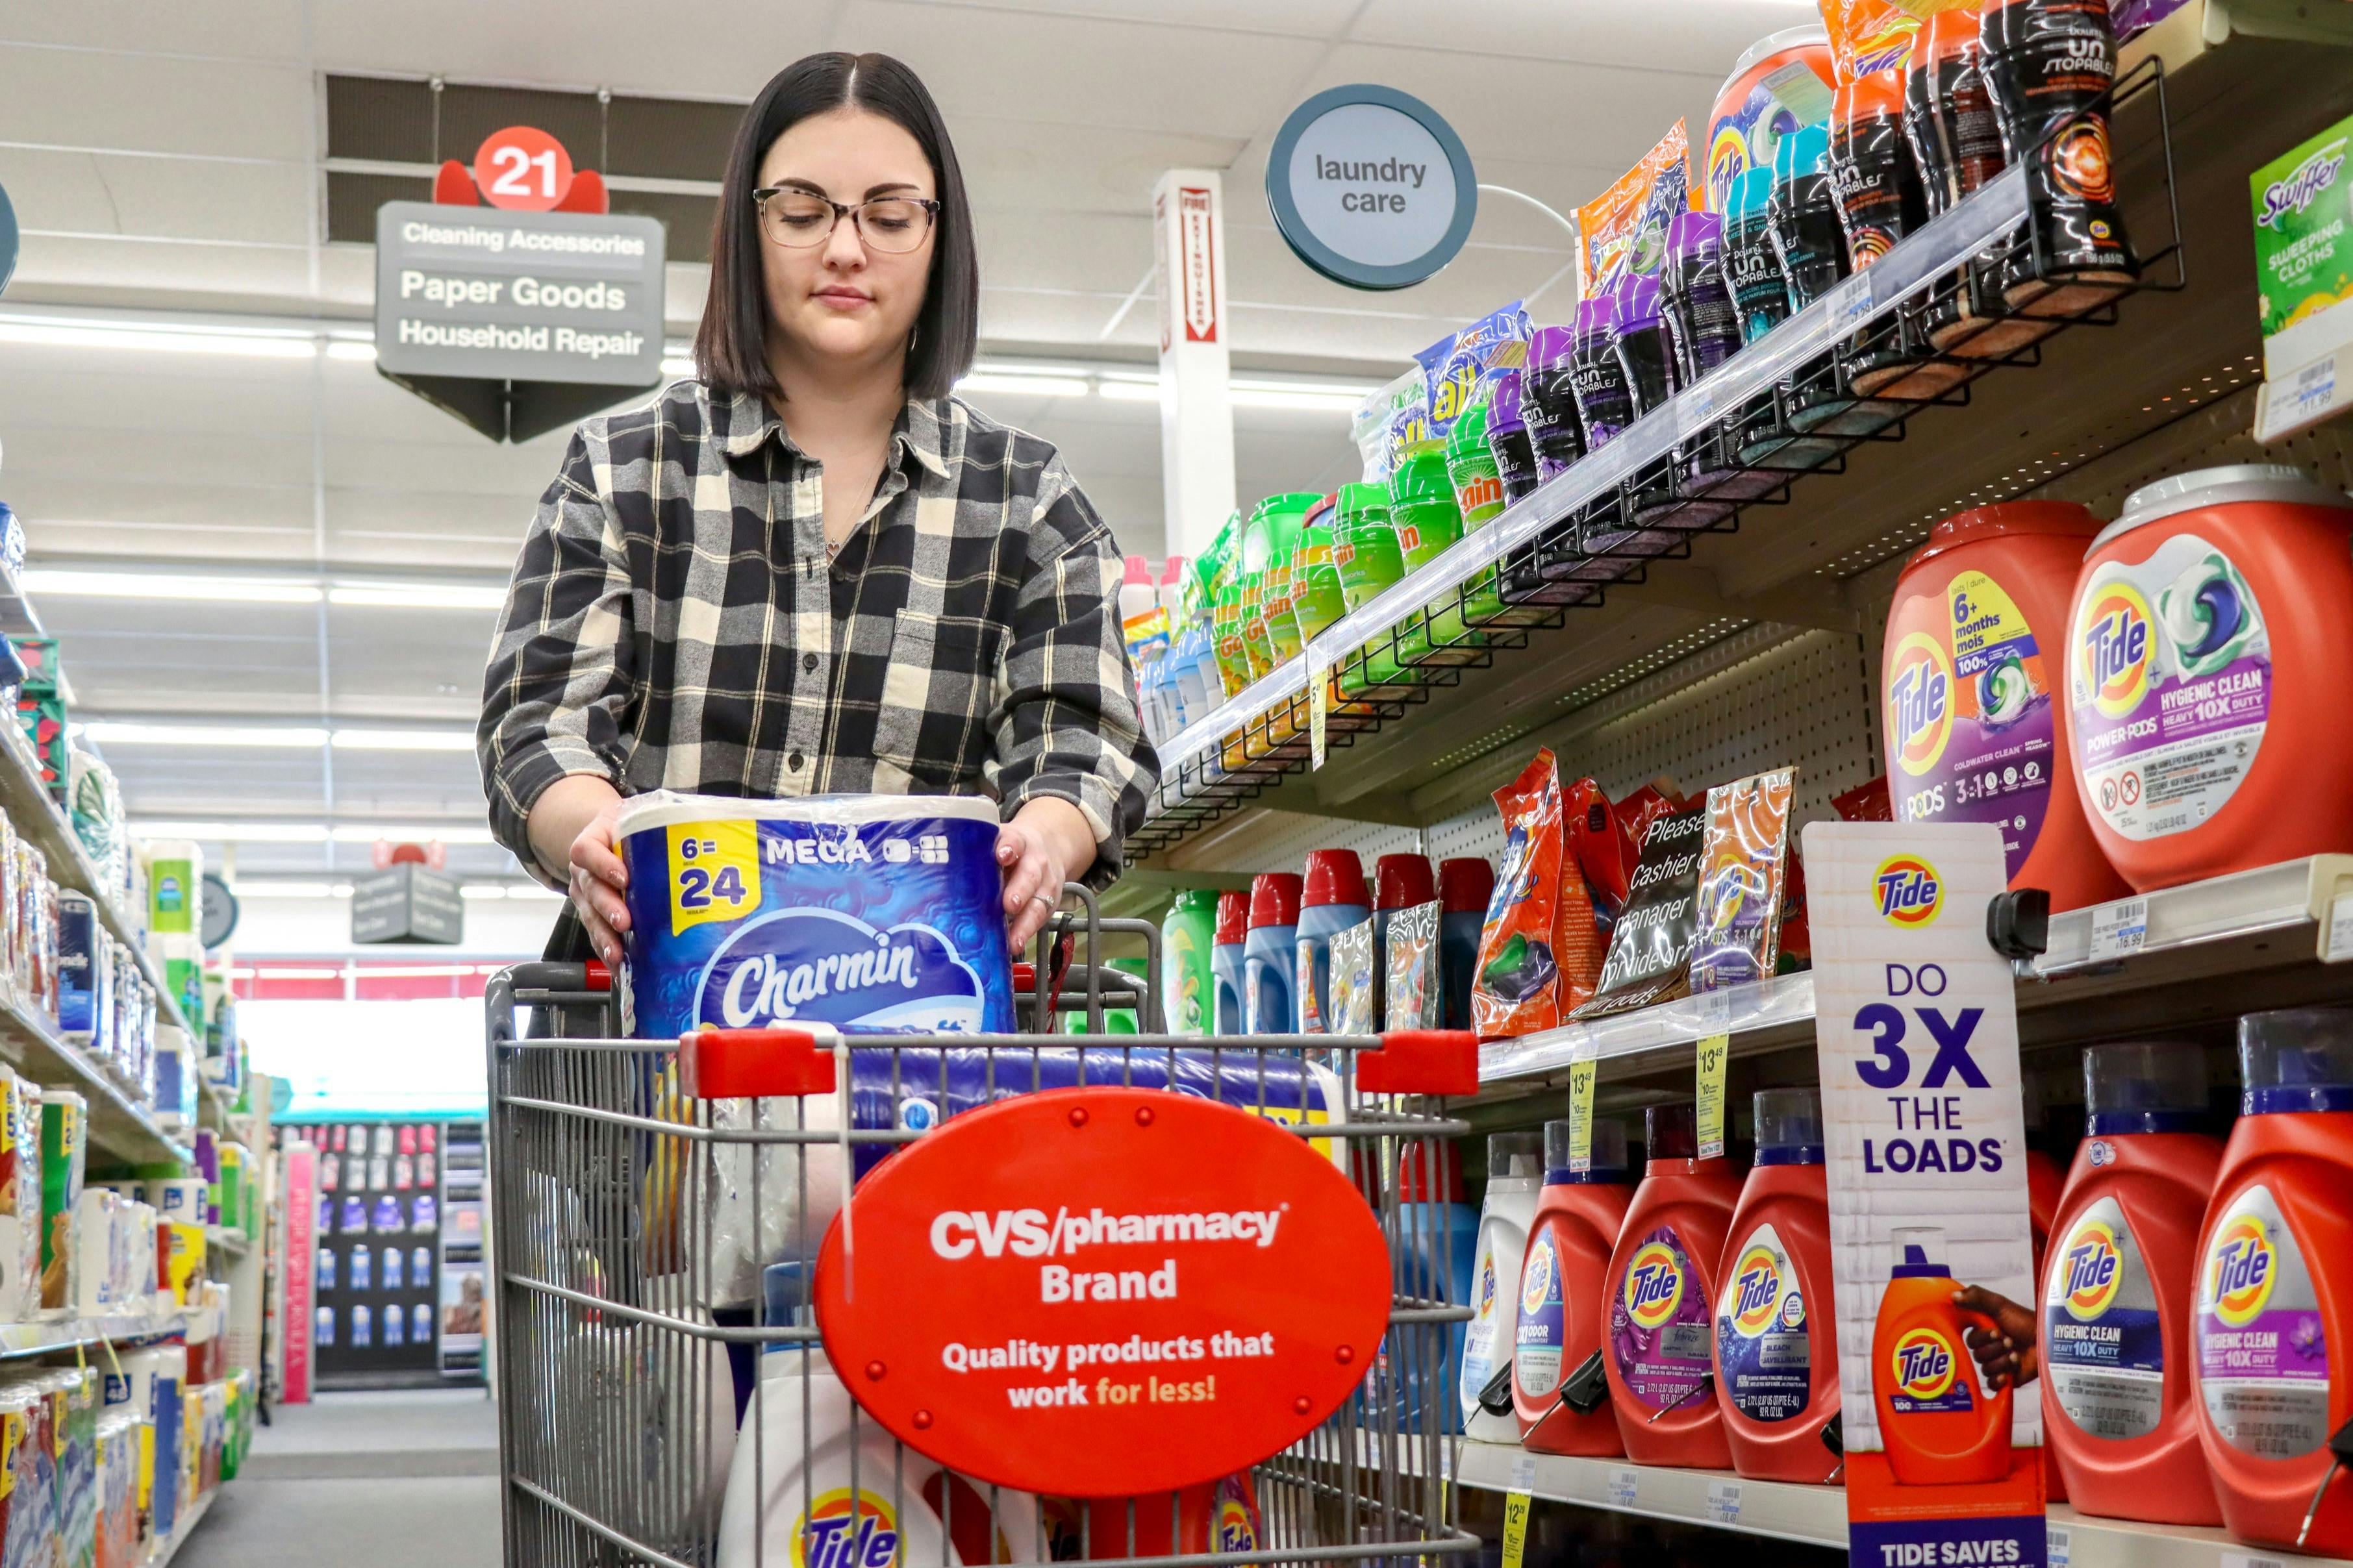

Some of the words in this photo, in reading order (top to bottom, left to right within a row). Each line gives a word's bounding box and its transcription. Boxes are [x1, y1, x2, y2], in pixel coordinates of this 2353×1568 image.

[492, 146, 557, 197] 21
[1316, 155, 1427, 189] laundry
[1839, 175, 1881, 199] PABLES
[1184, 197, 1207, 210] FIRE
[1341, 190, 1406, 214] care
[2257, 155, 2345, 227] Swiffer
[403, 221, 505, 251] Cleaning
[509, 229, 646, 256] Accessories
[1734, 243, 1764, 260] Downy
[2269, 218, 2344, 271] SWEEPING
[1730, 267, 1783, 288] TOPABLES
[2278, 241, 2335, 282] CLOTHS
[400, 270, 503, 308] Paper
[511, 277, 626, 311] Goods
[399, 319, 549, 352] Household
[555, 327, 644, 360] Repair
[1433, 366, 1476, 422] all
[1578, 378, 1617, 396] OPABLES
[1530, 414, 1560, 429] PABLES
[1461, 477, 1502, 514] ain
[1398, 527, 1420, 553] in
[1951, 584, 1965, 595] lasts
[1970, 577, 1986, 588] dure
[1246, 617, 1267, 643] Ga
[1955, 614, 2000, 640] months
[1220, 634, 1243, 659] Ga
[1956, 635, 1985, 654] mois
[2085, 607, 2146, 701] Tide
[1957, 656, 1988, 675] 100%
[2160, 680, 2217, 712] HYGIENIC
[2217, 669, 2263, 695] CLEAN
[1891, 658, 1946, 764] Tide
[2163, 710, 2195, 727] HEAVY
[2195, 697, 2232, 722] 10X
[2232, 694, 2263, 710] DUTY
[2087, 729, 2126, 754] POWER
[2127, 717, 2158, 738] PODS
[1954, 753, 1994, 771] COLDWATER
[1994, 745, 2020, 759] CLEAN
[1907, 784, 1946, 822] PODS
[1644, 812, 1705, 846] Please
[766, 838, 873, 865] MEGA
[679, 865, 747, 909] 24
[1630, 851, 1693, 891] Cashier
[1878, 870, 1938, 917] Tide
[1615, 895, 1691, 932] manager
[722, 932, 918, 1028] Charmin
[1885, 963, 1947, 997] DO
[1853, 1002, 1992, 1089] 3X
[1887, 1096, 1963, 1131] THE
[1862, 1138, 2004, 1174] LOADS
[1040, 1260, 1177, 1303] Brand
[1525, 1260, 1548, 1297] Tide
[1630, 1263, 1678, 1312] Tide
[2064, 1242, 2117, 1299] Tide
[2215, 1238, 2269, 1304] Tide
[1734, 1267, 1779, 1321] Tide
[1516, 1326, 1528, 1343] OXI
[1528, 1325, 1549, 1338] ODOR
[2053, 1343, 2073, 1353] HEAVY
[2073, 1341, 2098, 1358] 10X
[2097, 1347, 2119, 1356] DUTY
[2054, 1324, 2090, 1341] HYGIENIC
[2090, 1326, 2121, 1343] CLEAN
[2204, 1333, 2243, 1350] HYGIENIC
[2243, 1332, 2278, 1349] CLEAN
[941, 1339, 1061, 1374] Quality
[1066, 1333, 1205, 1371] products
[1209, 1331, 1275, 1359] that
[1898, 1344, 1949, 1388] Tide
[2224, 1350, 2252, 1368] 10X
[2252, 1355, 2278, 1365] DUTY
[1007, 1378, 1089, 1409] work
[1096, 1376, 1140, 1405] for
[1148, 1375, 1216, 1404] less!
[1647, 1383, 1655, 1393] 2.72
[1658, 1384, 1668, 1394] (2.87
[1668, 1384, 1674, 1393] US
[1674, 1384, 1689, 1394] QT/PTE
[1659, 1394, 1665, 1403] 92
[1665, 1395, 1670, 1403] FL
[1747, 1395, 1755, 1406] 2.72
[1757, 1395, 1767, 1408] (2.87
[1767, 1395, 1773, 1406] US
[1772, 1395, 1787, 1406] QT/PTE
[1894, 1401, 1912, 1410] 100
[1759, 1406, 1765, 1417] 92
[1765, 1407, 1770, 1417] FL
[1770, 1407, 1776, 1417] OZ
[1776, 1407, 1784, 1417] LIQ.
[806, 1515, 897, 1568] Tide
[1880, 1542, 1938, 1567] TIDE
[1940, 1539, 2020, 1564] SAVES
